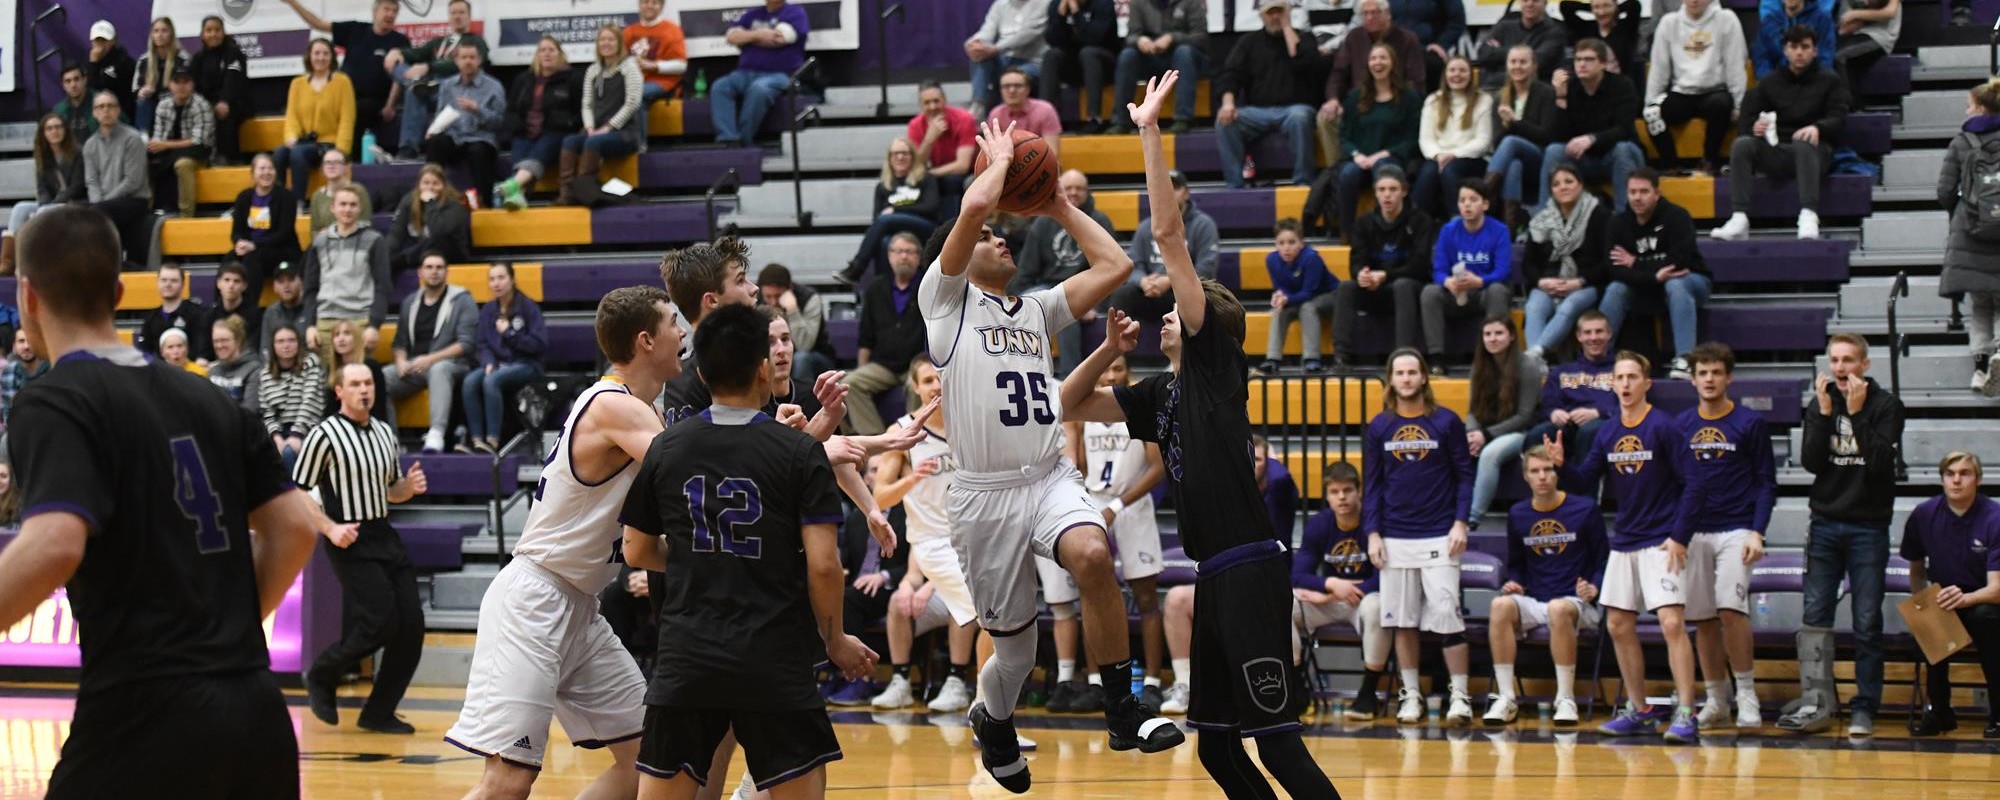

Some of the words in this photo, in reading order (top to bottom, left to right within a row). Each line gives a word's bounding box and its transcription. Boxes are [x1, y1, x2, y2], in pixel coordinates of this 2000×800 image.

[527, 20, 569, 32] NORTH
[995, 371, 1056, 427] 35
[1087, 434, 1131, 452] UNW
[169, 434, 231, 555] 4
[1100, 460, 1114, 490] 4
[682, 474, 763, 560] 12
